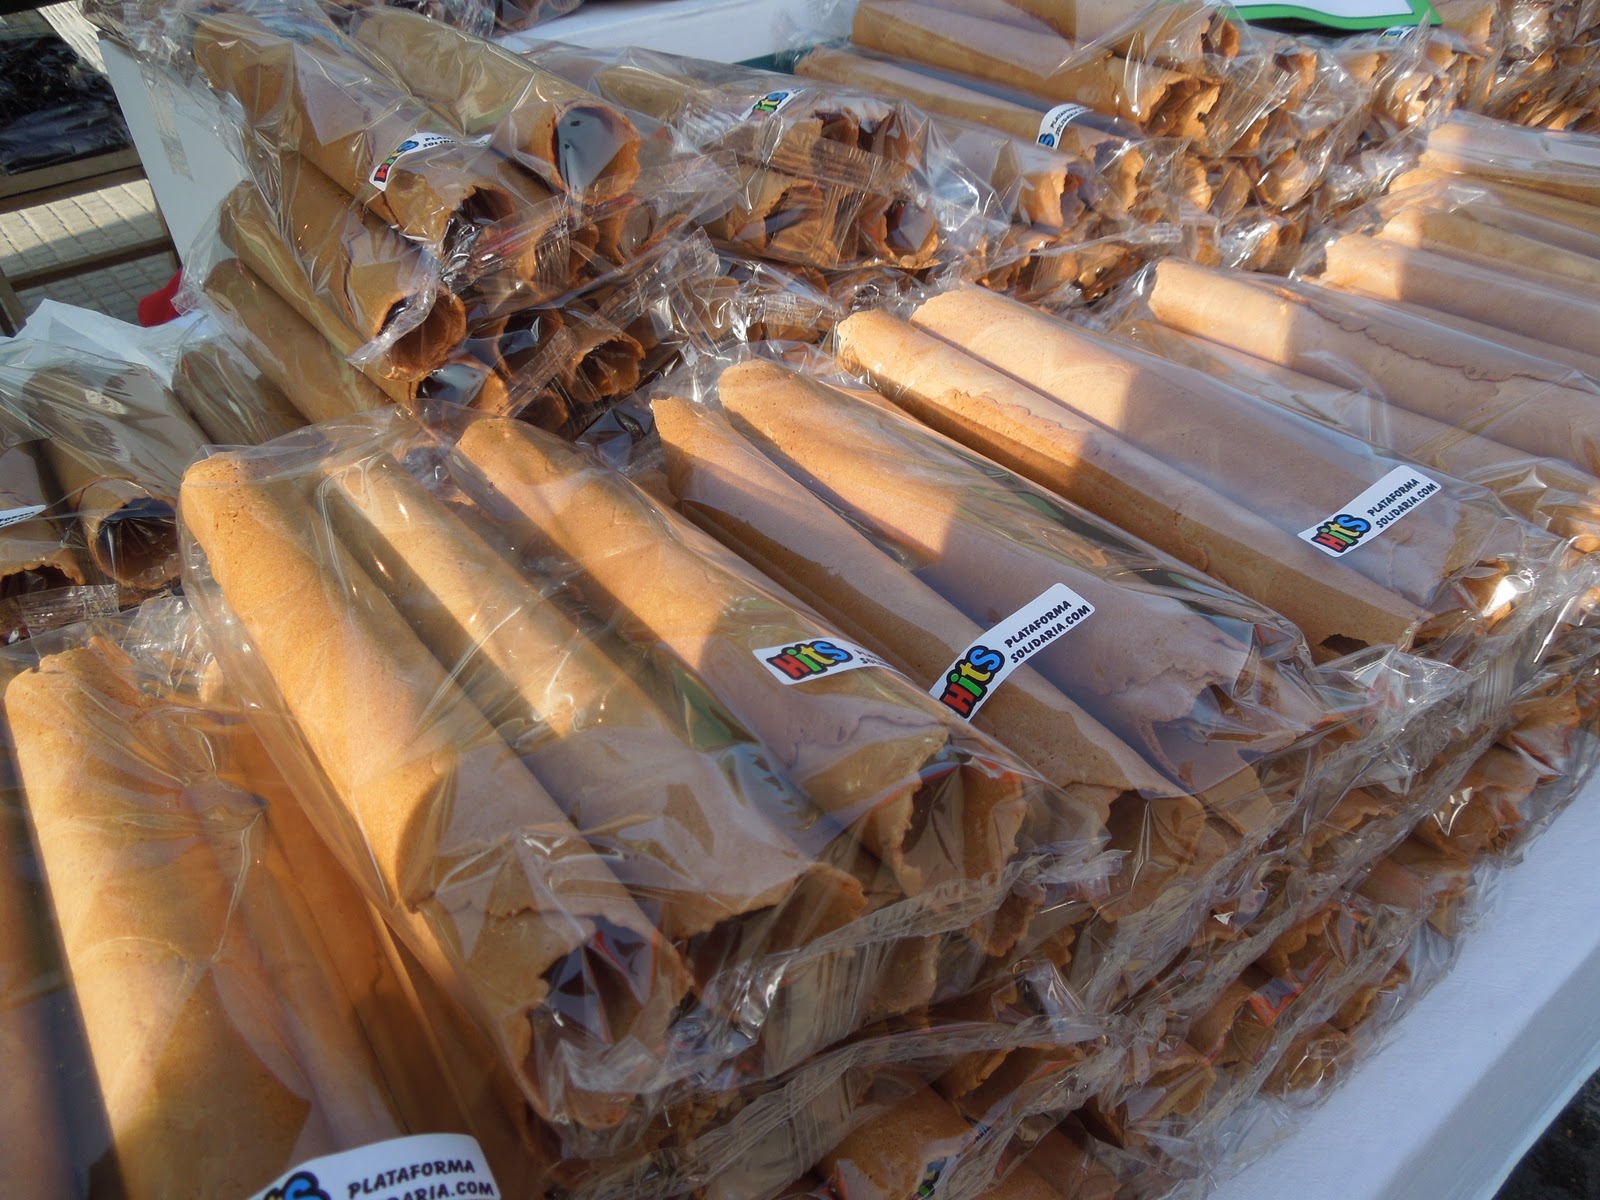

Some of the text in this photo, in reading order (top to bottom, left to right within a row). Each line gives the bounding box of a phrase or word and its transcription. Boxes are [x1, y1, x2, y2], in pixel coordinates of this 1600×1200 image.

[1367, 478, 1421, 517] PLATAFORMA
[1375, 482, 1438, 529] SOLIDARIA.COM
[1004, 600, 1073, 648] PLATAFORMA
[1010, 604, 1091, 664] SOLIDARIA.COM
[347, 1159, 476, 1199] PLATAFORMA
[387, 1180, 494, 1200] ARIA.COM
